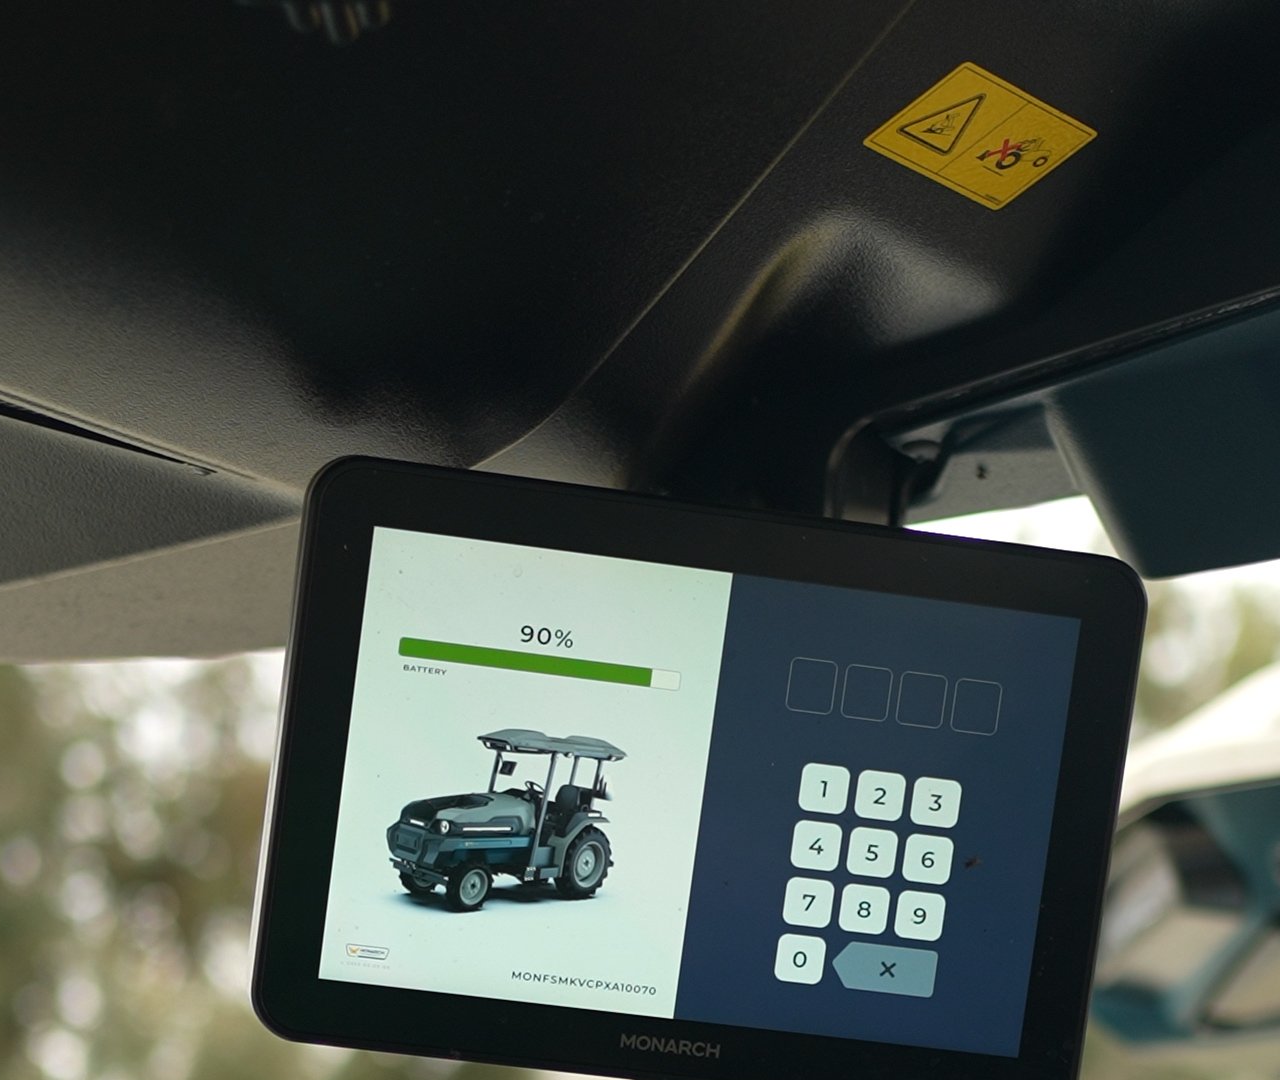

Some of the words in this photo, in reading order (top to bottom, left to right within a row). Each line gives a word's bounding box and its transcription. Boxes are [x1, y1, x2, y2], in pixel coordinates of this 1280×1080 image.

[520, 625, 574, 649] 90%
[403, 664, 447, 676] BATTERY
[821, 781, 827, 797] 1
[873, 788, 886, 805] 2
[929, 794, 942, 811] 3
[809, 838, 823, 854] 4
[865, 845, 878, 861] 5
[922, 852, 934, 868] 6
[803, 894, 816, 911] 7
[857, 901, 871, 918] 8
[914, 908, 926, 924] 9
[793, 951, 807, 968] 0
[511, 970, 657, 996] MONFSMKVCPXA10070
[619, 1033, 721, 1059] MONARCH
